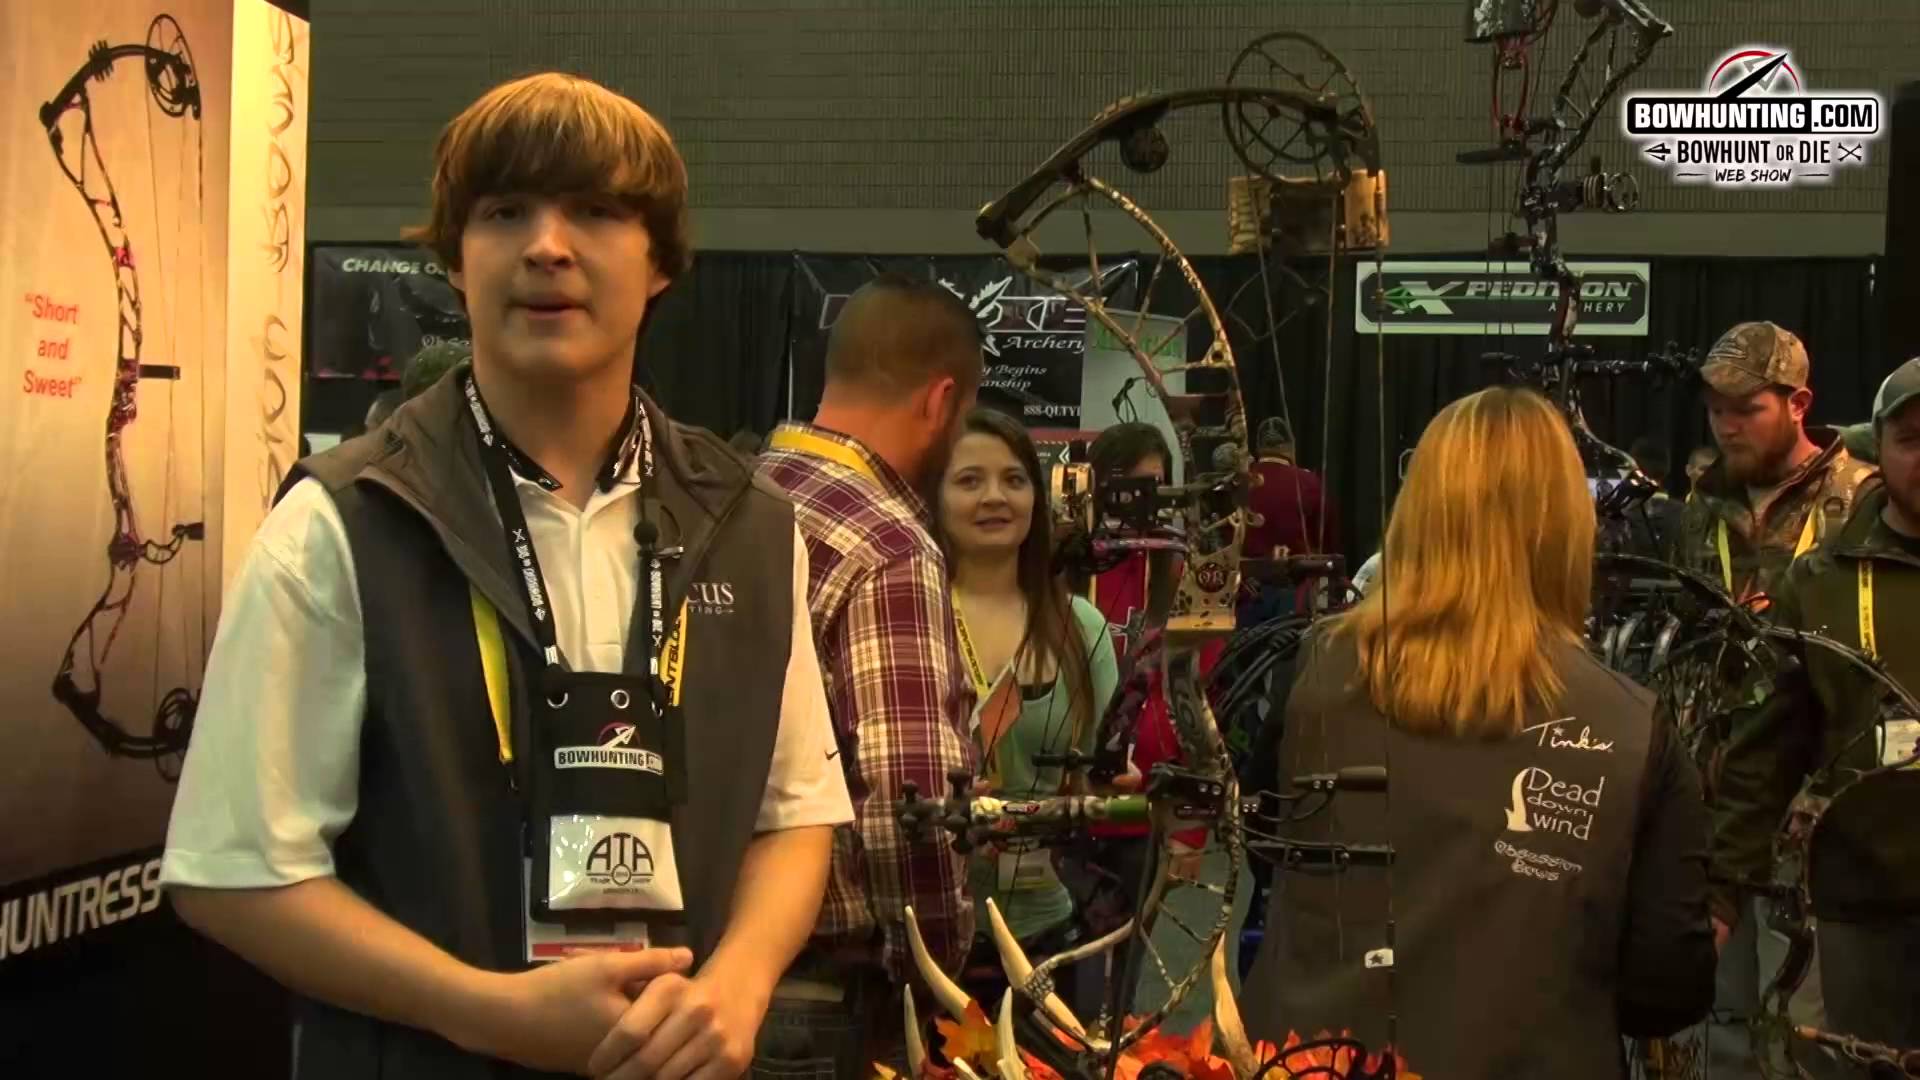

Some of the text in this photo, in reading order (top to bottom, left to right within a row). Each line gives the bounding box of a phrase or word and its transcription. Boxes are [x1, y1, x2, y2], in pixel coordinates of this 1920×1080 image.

[342, 258, 421, 275] CHANGE
[38, 338, 69, 361] and
[1002, 334, 1085, 355] Archery
[995, 364, 1048, 379] Begins
[557, 750, 645, 767] BOWHUNTING
[1527, 767, 1606, 807] Dead
[1526, 792, 1588, 816] down
[1532, 813, 1594, 841] wind
[586, 832, 655, 872] ATA
